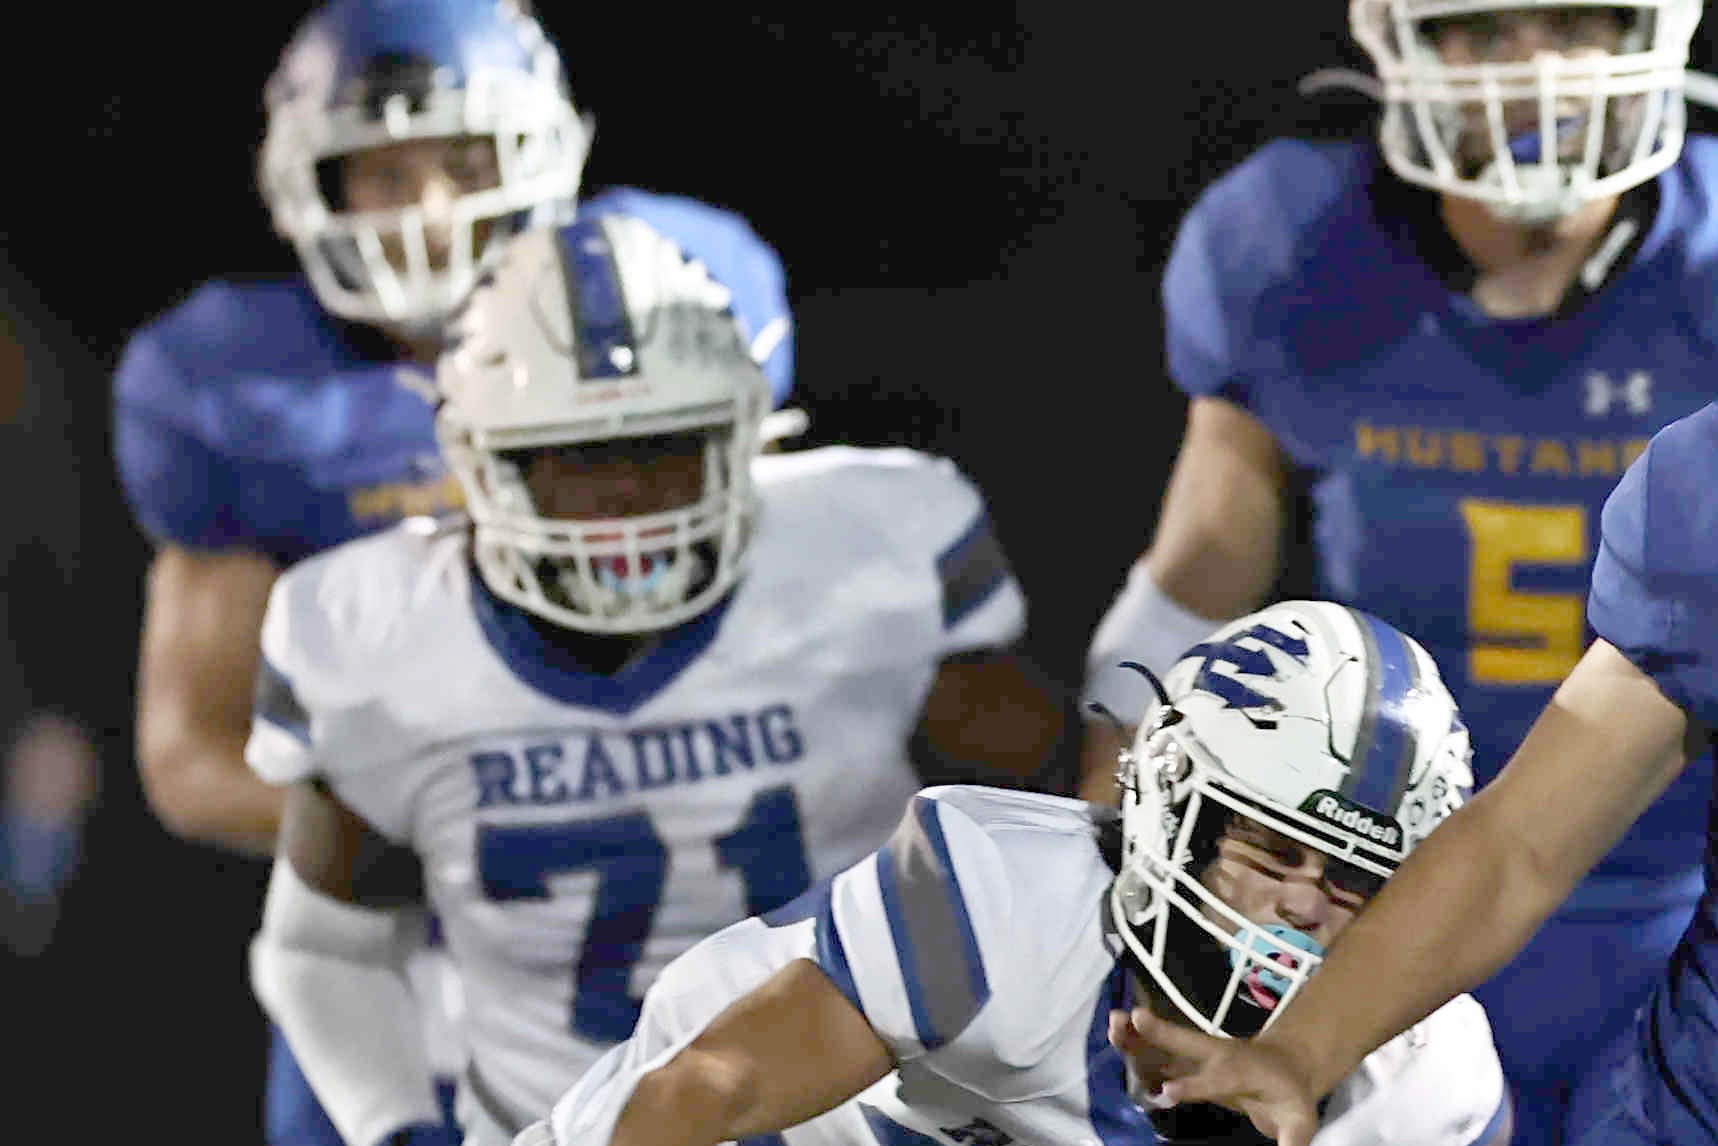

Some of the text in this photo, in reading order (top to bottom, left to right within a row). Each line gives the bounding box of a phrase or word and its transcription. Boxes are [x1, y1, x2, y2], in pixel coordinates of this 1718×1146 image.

[1355, 420, 1650, 476] MUSTAN
[1459, 500, 1586, 686] 5
[469, 704, 804, 806] READING
[1316, 796, 1398, 845] Riddell
